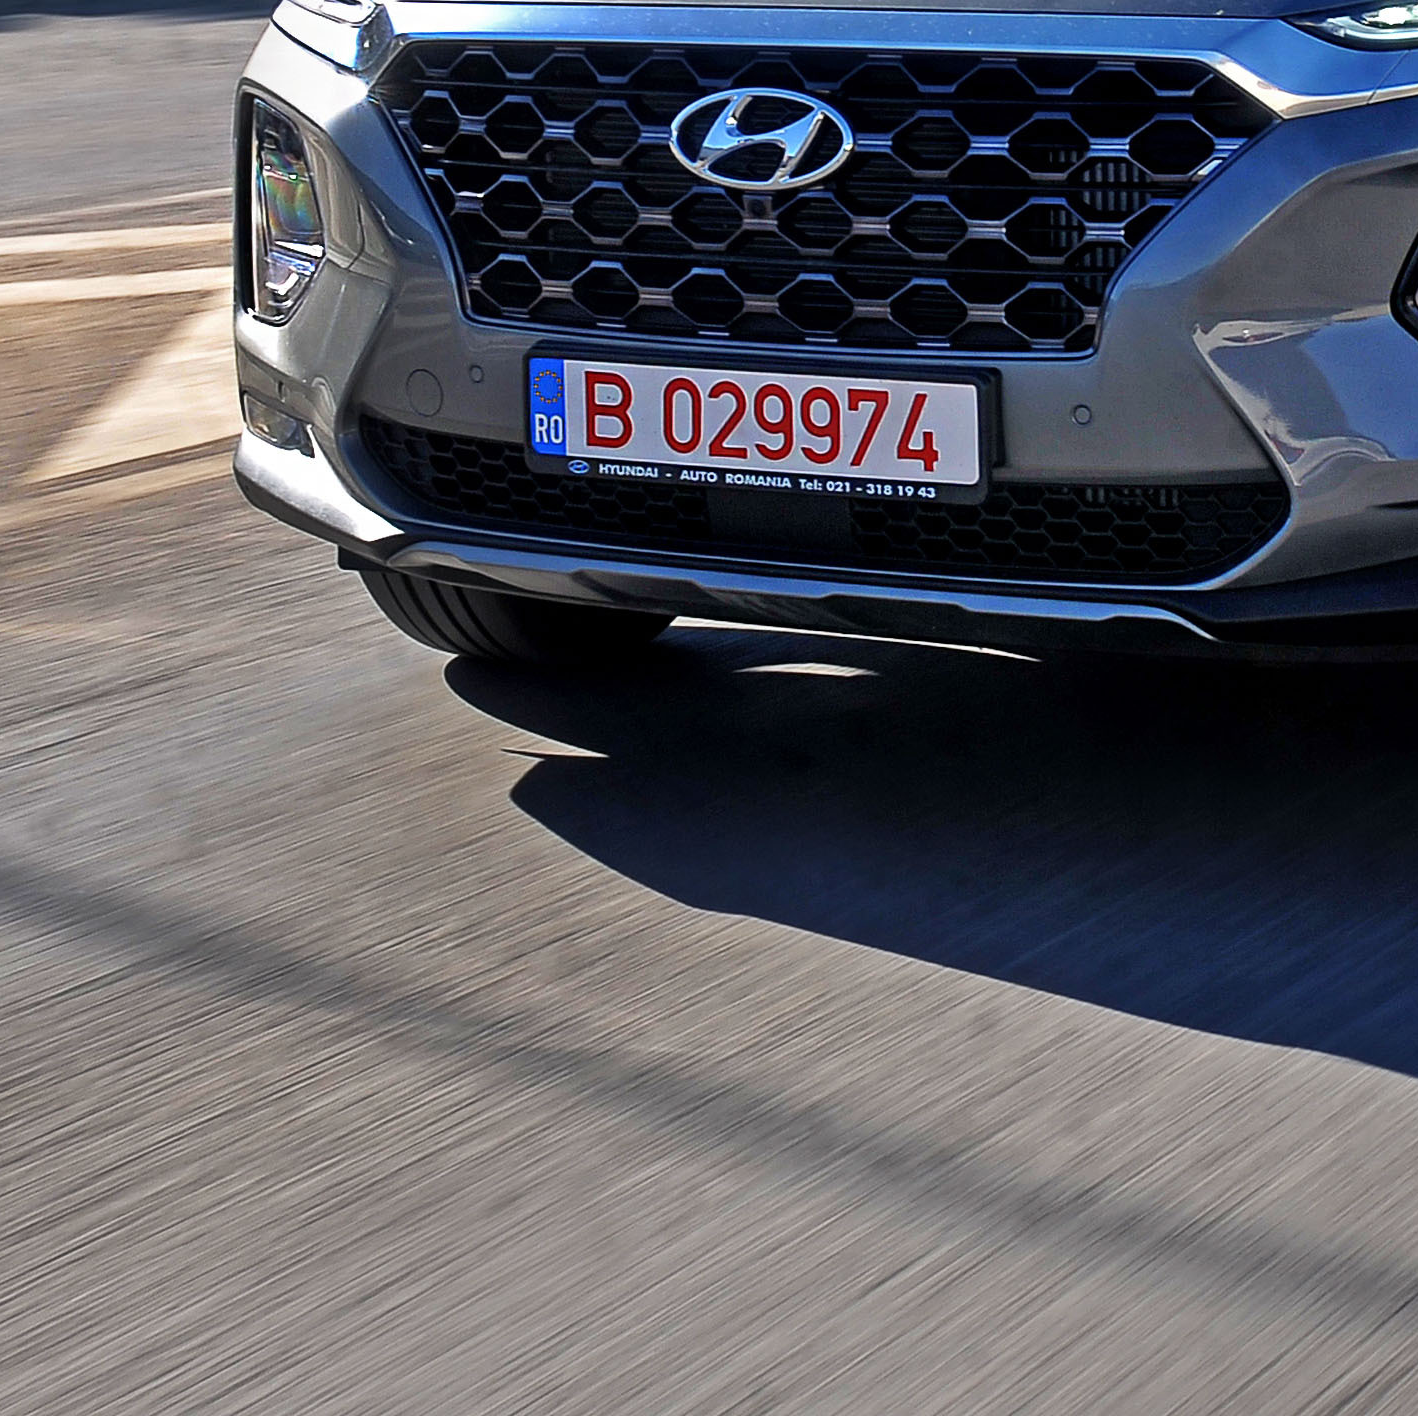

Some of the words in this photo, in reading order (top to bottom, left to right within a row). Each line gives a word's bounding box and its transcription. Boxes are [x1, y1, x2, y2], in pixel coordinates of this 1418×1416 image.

[534, 413, 563, 444] RO
[584, 370, 634, 449] B
[662, 376, 939, 472] 029974
[599, 463, 658, 478] HYUNDAI
[680, 469, 718, 483] AUTO
[725, 473, 792, 488] ROMANIA
[799, 478, 822, 491] Tel:
[826, 480, 851, 493] 021
[866, 482, 893, 496] 318
[898, 485, 914, 497] 19
[917, 487, 936, 499] 43
